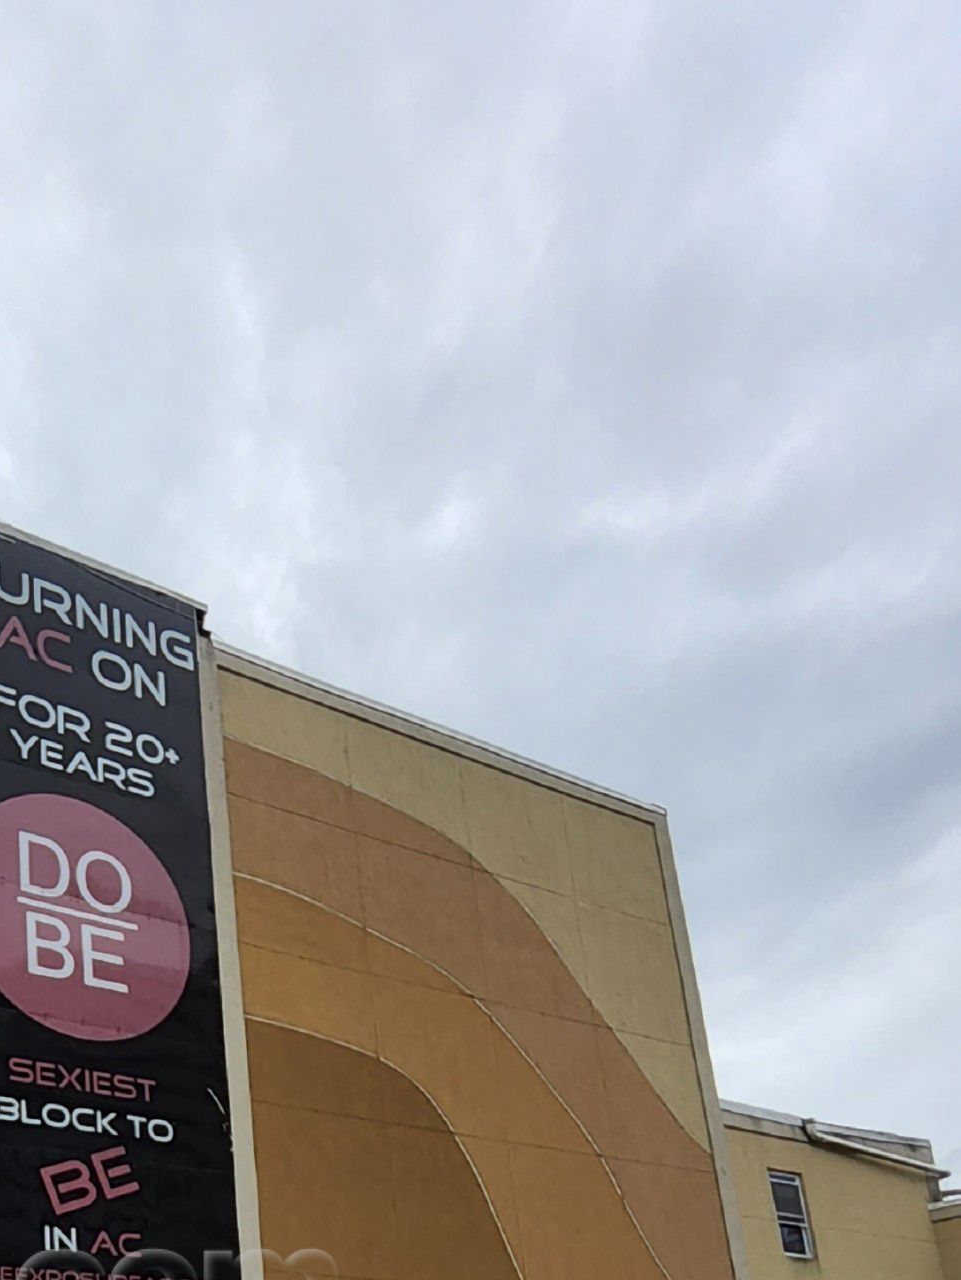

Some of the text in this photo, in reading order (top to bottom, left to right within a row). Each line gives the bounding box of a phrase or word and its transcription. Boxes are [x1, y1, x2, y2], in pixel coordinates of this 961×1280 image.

[91, 650, 167, 707] ON
[9, 728, 156, 798] YEARS
[104, 720, 180, 765] 20+
[18, 830, 133, 914] DO
[25, 910, 129, 994] BE
[8, 1057, 156, 1102] SEXIEST
[126, 1115, 175, 1143] TO
[39, 1145, 140, 1216] BE
[43, 1224, 143, 1257] IN AC
